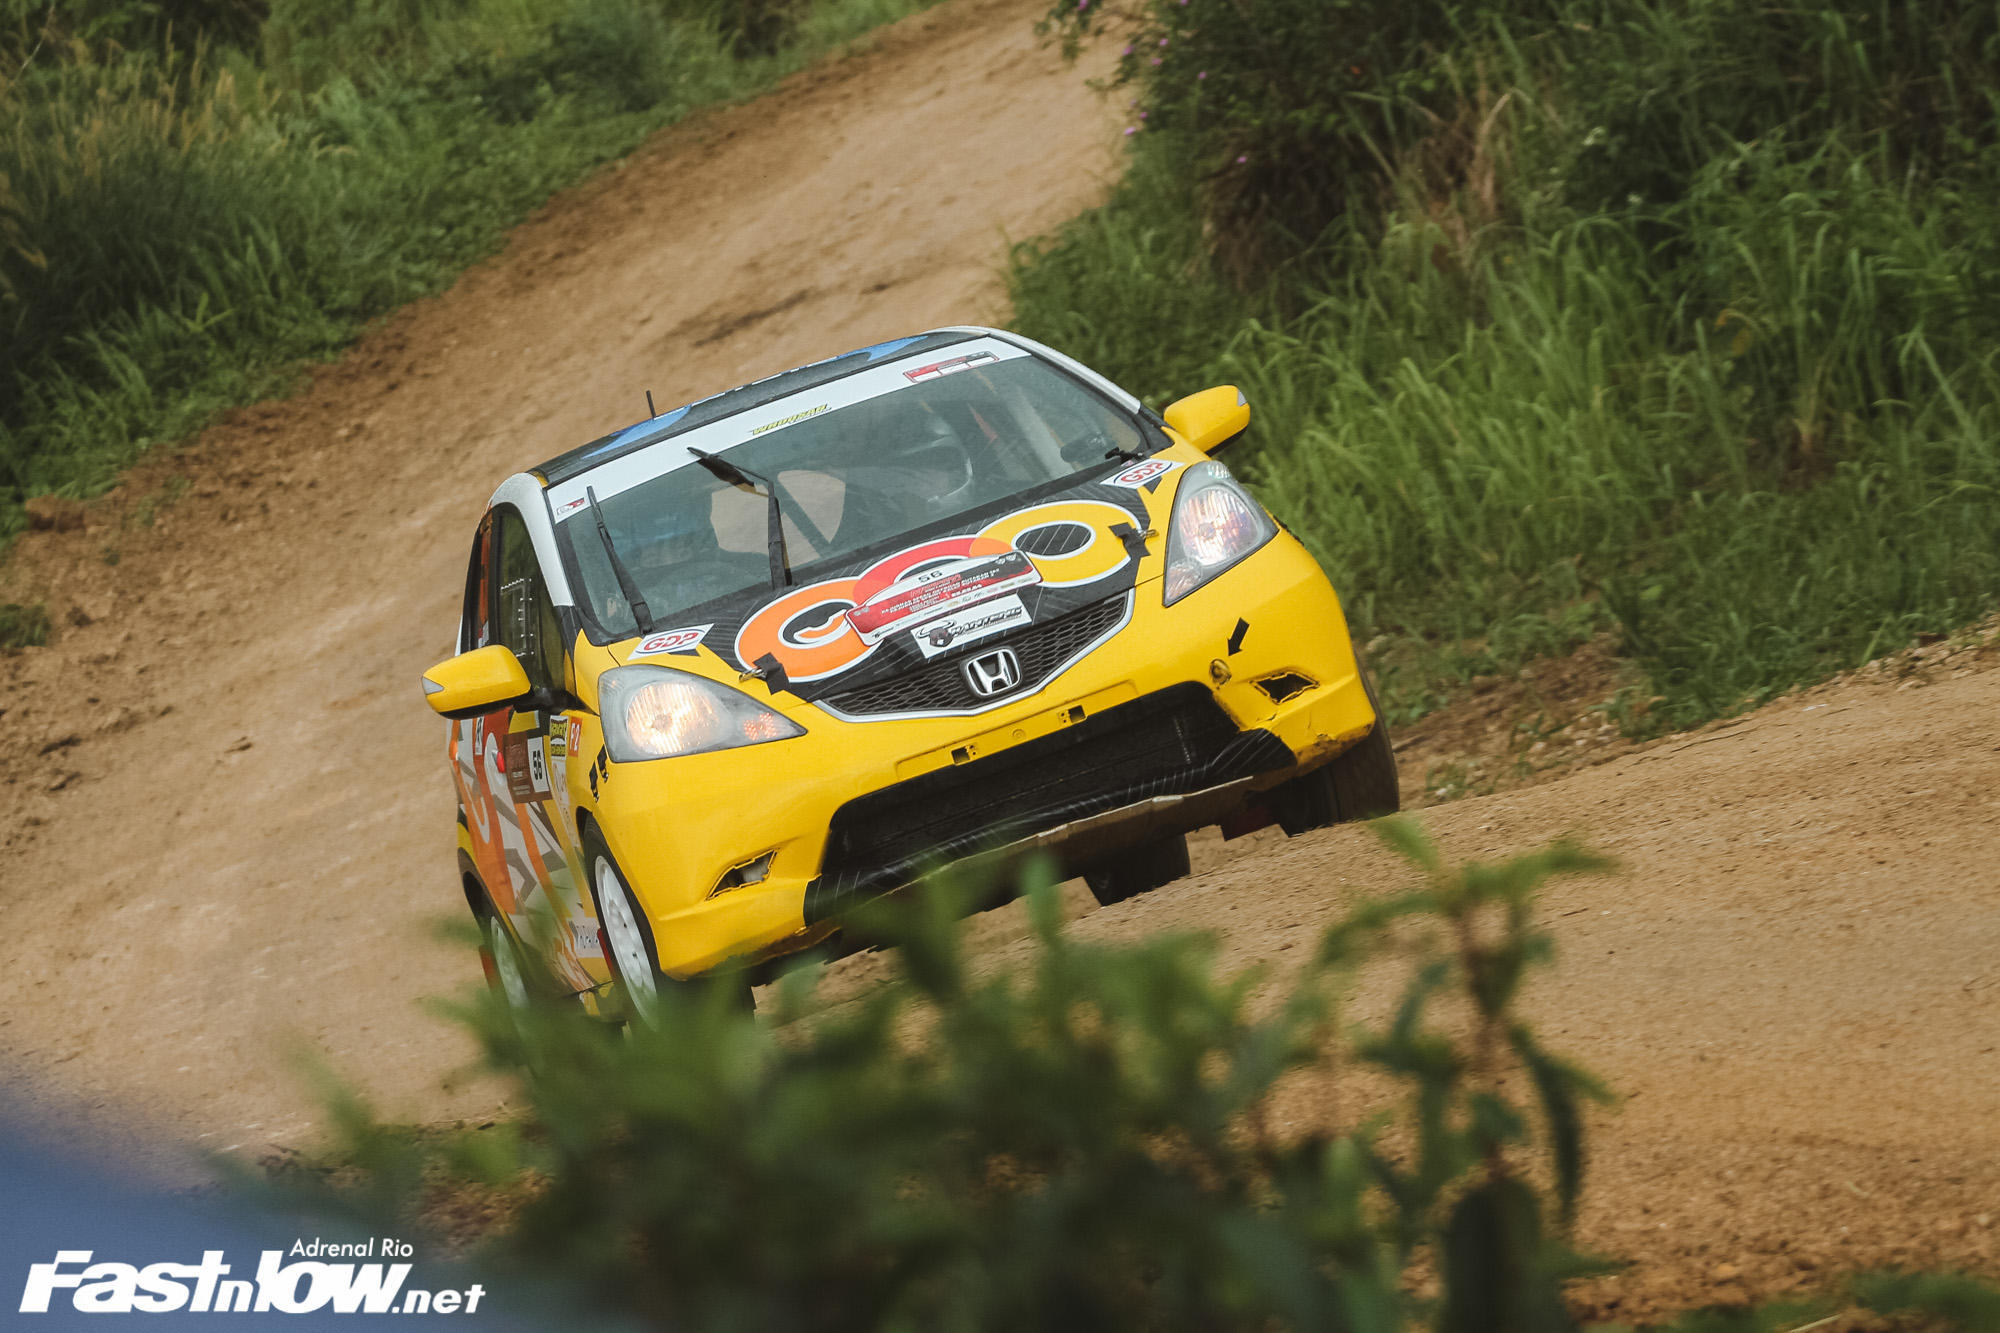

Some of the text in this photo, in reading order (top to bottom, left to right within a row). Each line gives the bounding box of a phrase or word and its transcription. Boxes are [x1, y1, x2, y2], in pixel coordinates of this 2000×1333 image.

[918, 570, 942, 583] 56
[643, 632, 699, 651] GDP
[532, 750, 543, 780] 56
